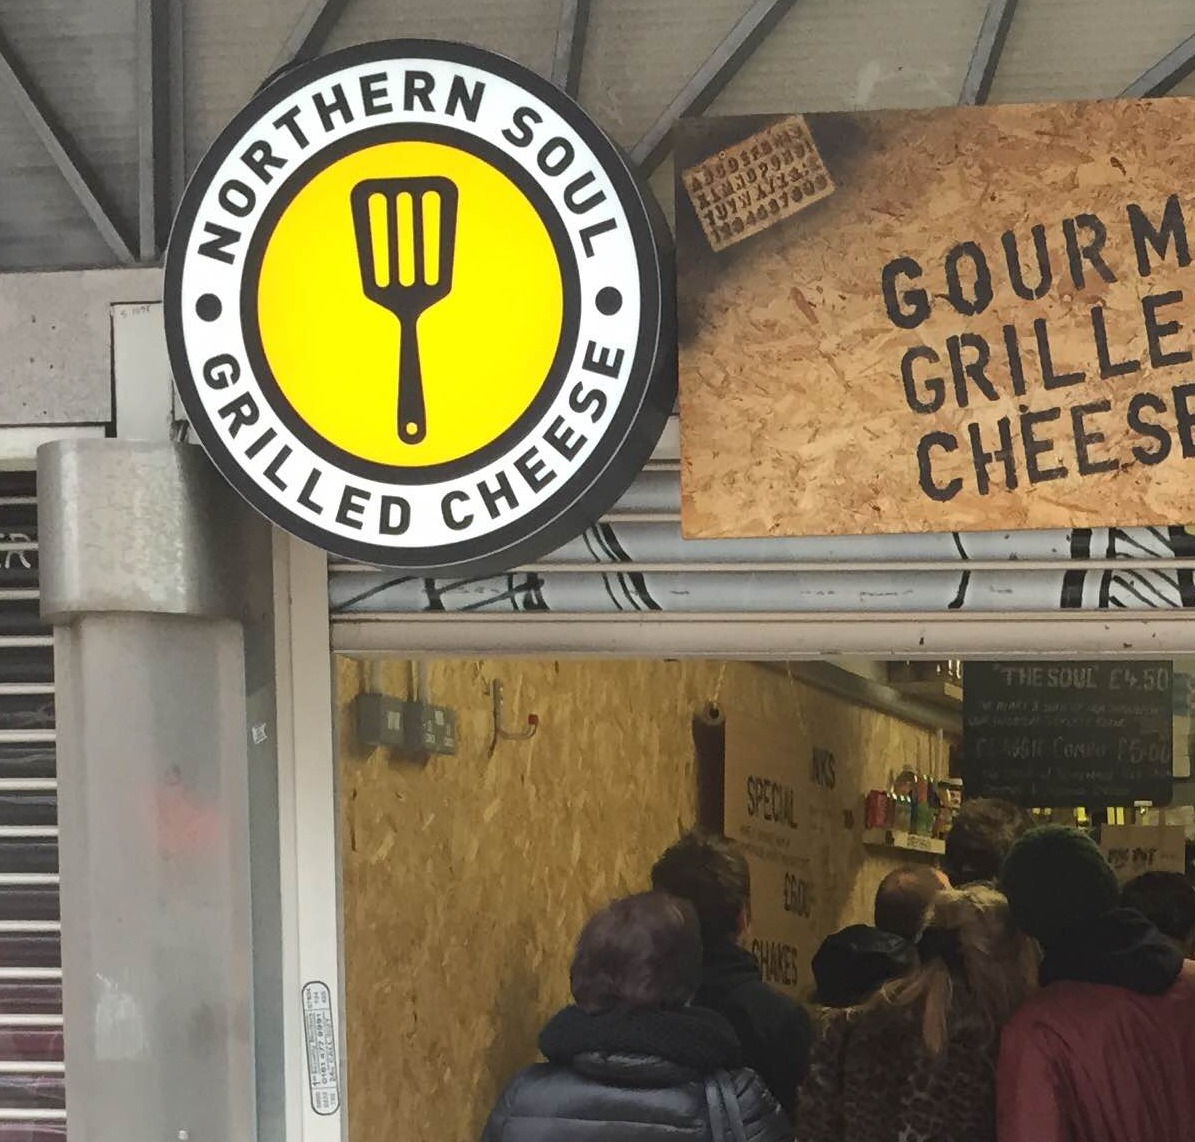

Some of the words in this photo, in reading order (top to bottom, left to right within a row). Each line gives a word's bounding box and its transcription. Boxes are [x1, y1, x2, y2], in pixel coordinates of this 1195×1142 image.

[197, 70, 486, 264] NORTHERN
[501, 106, 618, 258] SOUL
[202, 353, 411, 535] GRILLED
[440, 340, 625, 531] CHEESE
